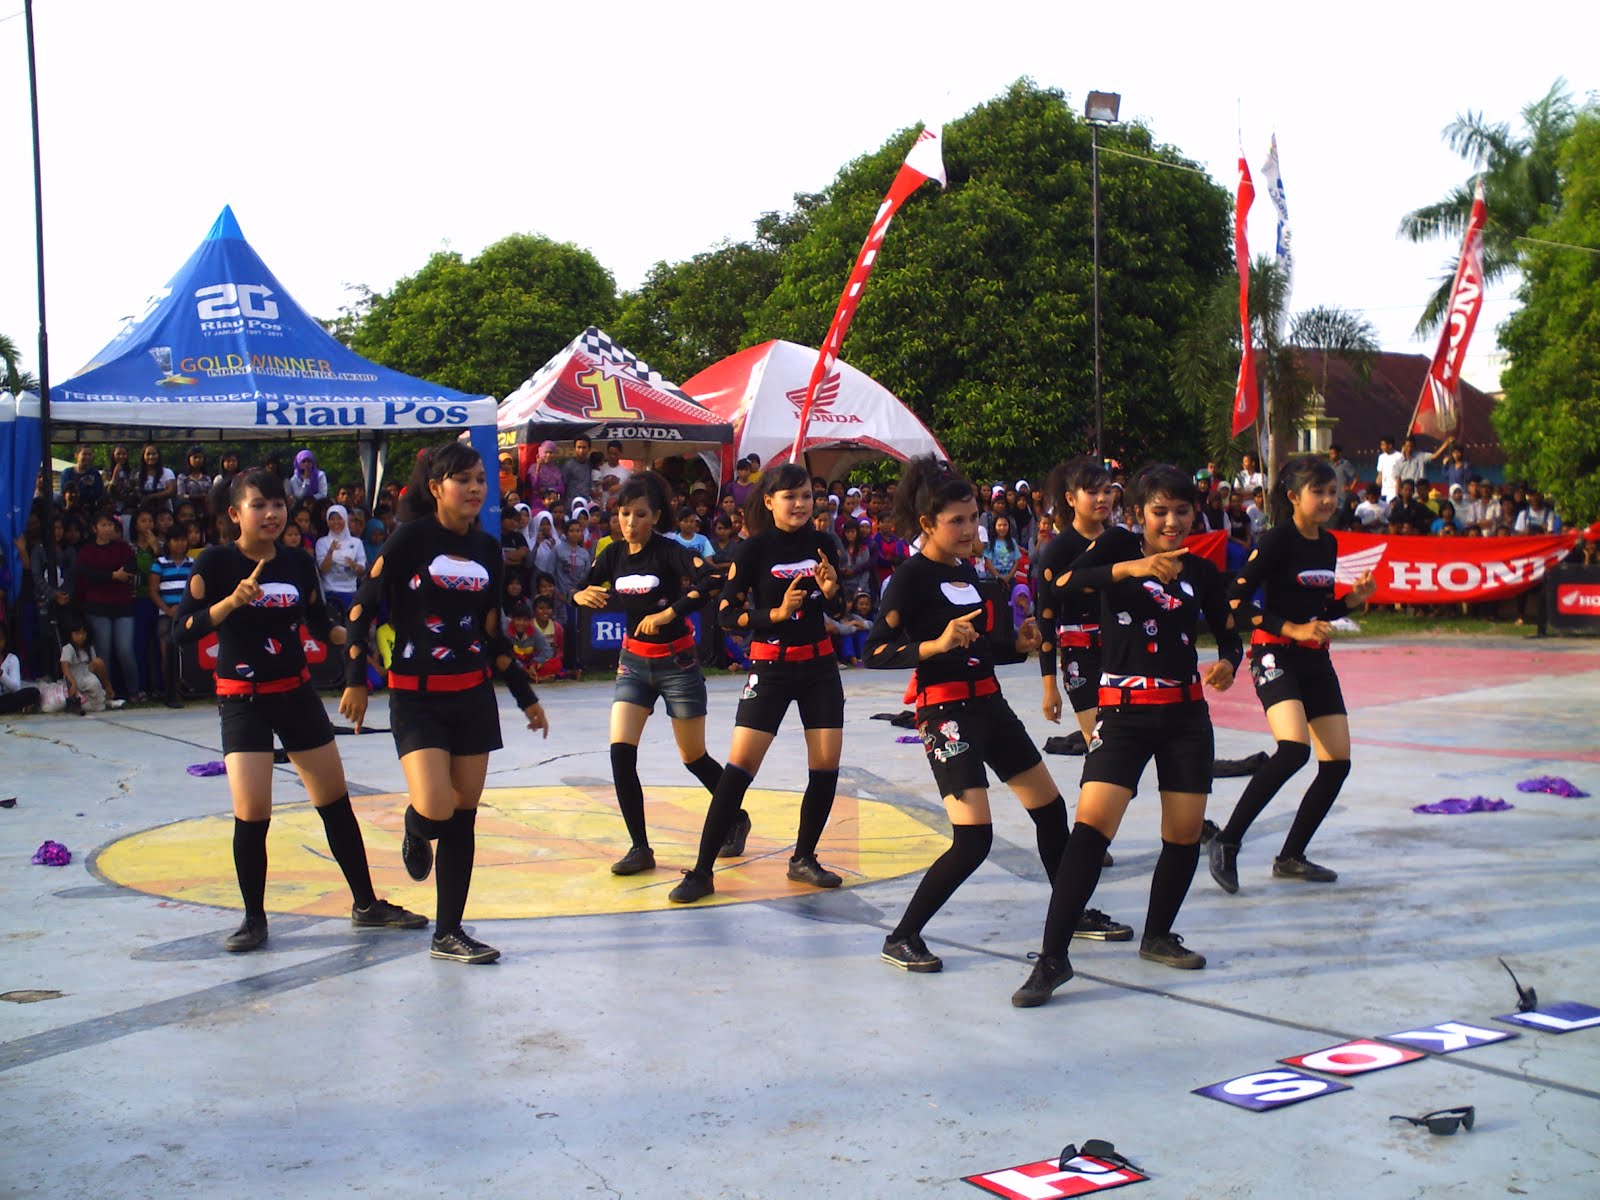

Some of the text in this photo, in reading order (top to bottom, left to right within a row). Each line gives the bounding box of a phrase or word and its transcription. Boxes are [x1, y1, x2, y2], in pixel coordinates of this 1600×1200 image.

[200, 319, 282, 331] Riau Pos
[180, 353, 243, 373] GOLD
[338, 372, 378, 382] AWARD
[61, 389, 168, 403] TERBESAR
[174, 390, 278, 403] TERDEPAN
[283, 394, 373, 402] PERTAMA
[255, 401, 469, 427] Riau Pos
[607, 426, 683, 440] HONDA
